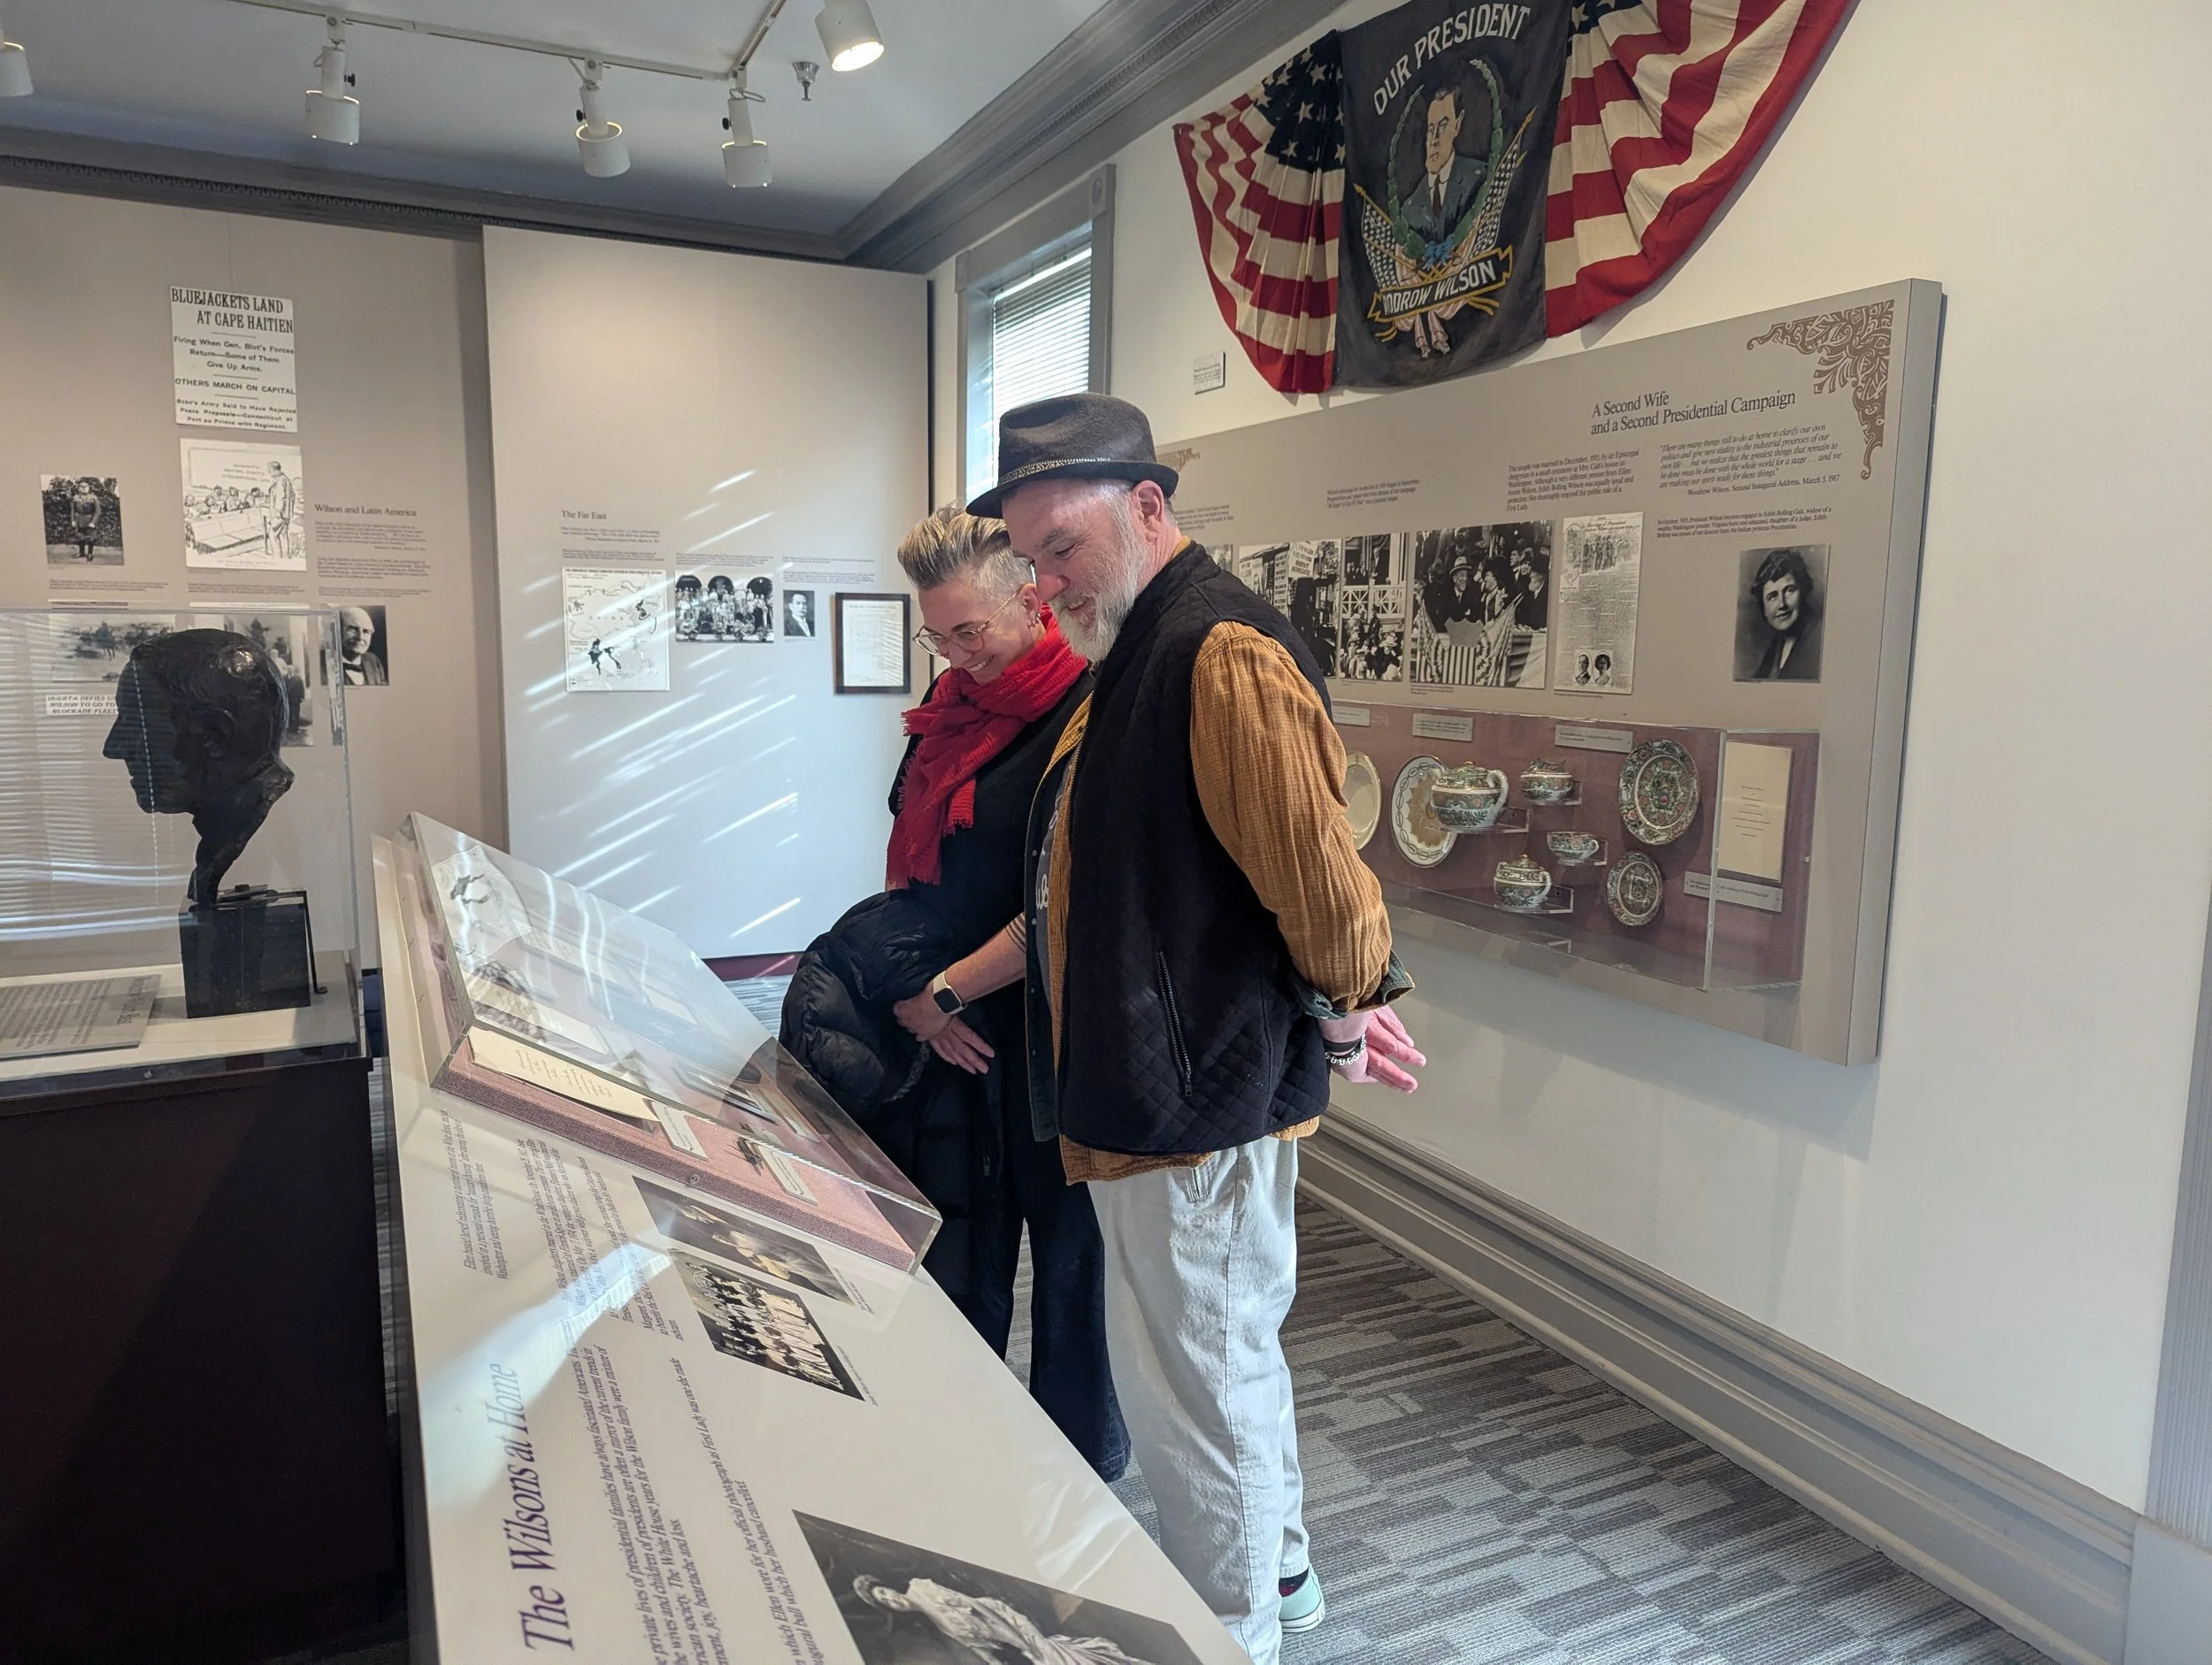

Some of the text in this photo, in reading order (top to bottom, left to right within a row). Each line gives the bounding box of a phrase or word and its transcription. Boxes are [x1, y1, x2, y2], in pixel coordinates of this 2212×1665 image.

[1373, 3, 1531, 116] OUR PRESIDENT
[1433, 259, 1497, 301] WILSON
[171, 288, 284, 314] BLUEJACKETS LAND
[196, 311, 293, 334] AT CAPE HAITIEN
[173, 335, 196, 346] Firing
[224, 341, 242, 349] Gen.
[244, 342, 266, 352] Blot's
[269, 346, 295, 355] Forces
[226, 362, 237, 372] Up
[258, 355, 280, 364] Them
[174, 378, 296, 395] OTHERS MARCH ON CAPITAL
[1590, 389, 1796, 435] and a Second Presidential Campaign
[1591, 390, 1671, 418] A Second Wife
[1779, 426, 1799, 436] clarify
[1780, 436, 1809, 447] processes
[1809, 433, 1819, 443] of
[1793, 445, 1806, 454] that
[1806, 442, 1830, 452] remain
[1817, 451, 1832, 461] and
[314, 503, 342, 513] Wilson
[361, 506, 382, 515] Latin
[384, 508, 418, 517] America
[561, 510, 576, 519] The
[591, 511, 607, 520] East
[580, 1347, 593, 1355] in
[593, 1344, 607, 1354] of
[582, 1354, 599, 1376] trends
[599, 1354, 616, 1380] mixture
[589, 1375, 607, 1401] current
[610, 1385, 621, 1401] were
[597, 1400, 611, 1414] the
[597, 1411, 613, 1423] of
[612, 1402, 631, 1426] family
[604, 1422, 621, 1448] mirror
[692, 1416, 708, 1435] Lady
[622, 1426, 637, 1452] Wilson
[702, 1433, 716, 1452] First
[614, 1456, 630, 1477] often
[629, 1454, 644, 1468] the
[622, 1478, 635, 1493] are
[634, 1468, 649, 1482] for
[710, 1457, 741, 1508] photograph
[640, 1482, 659, 1506] years
[485, 1363, 575, 1652] The Wilsons at Home
[626, 1493, 652, 1540] presidents
[578, 1396, 668, 1655] private lives of presidential families have always fascinated
[648, 1506, 666, 1536] House
[729, 1504, 752, 1538] official
[634, 1537, 653, 1551] of
[657, 1537, 674, 1564] White
[672, 1537, 691, 1557] and
[733, 1480, 807, 1627] ball which her husband cancelled.
[744, 1537, 758, 1554] her
[750, 1553, 765, 1568] for
[643, 1552, 666, 1593] children
[666, 1569, 683, 1588] The
[681, 1558, 709, 1607] heartache
[757, 1567, 774, 1592] wore
[652, 1594, 673, 1617] and
[768, 1595, 788, 1622] Ellen
[700, 1611, 720, 1631] joy,
[664, 1618, 681, 1648] wives
[778, 1624, 801, 1655] which
